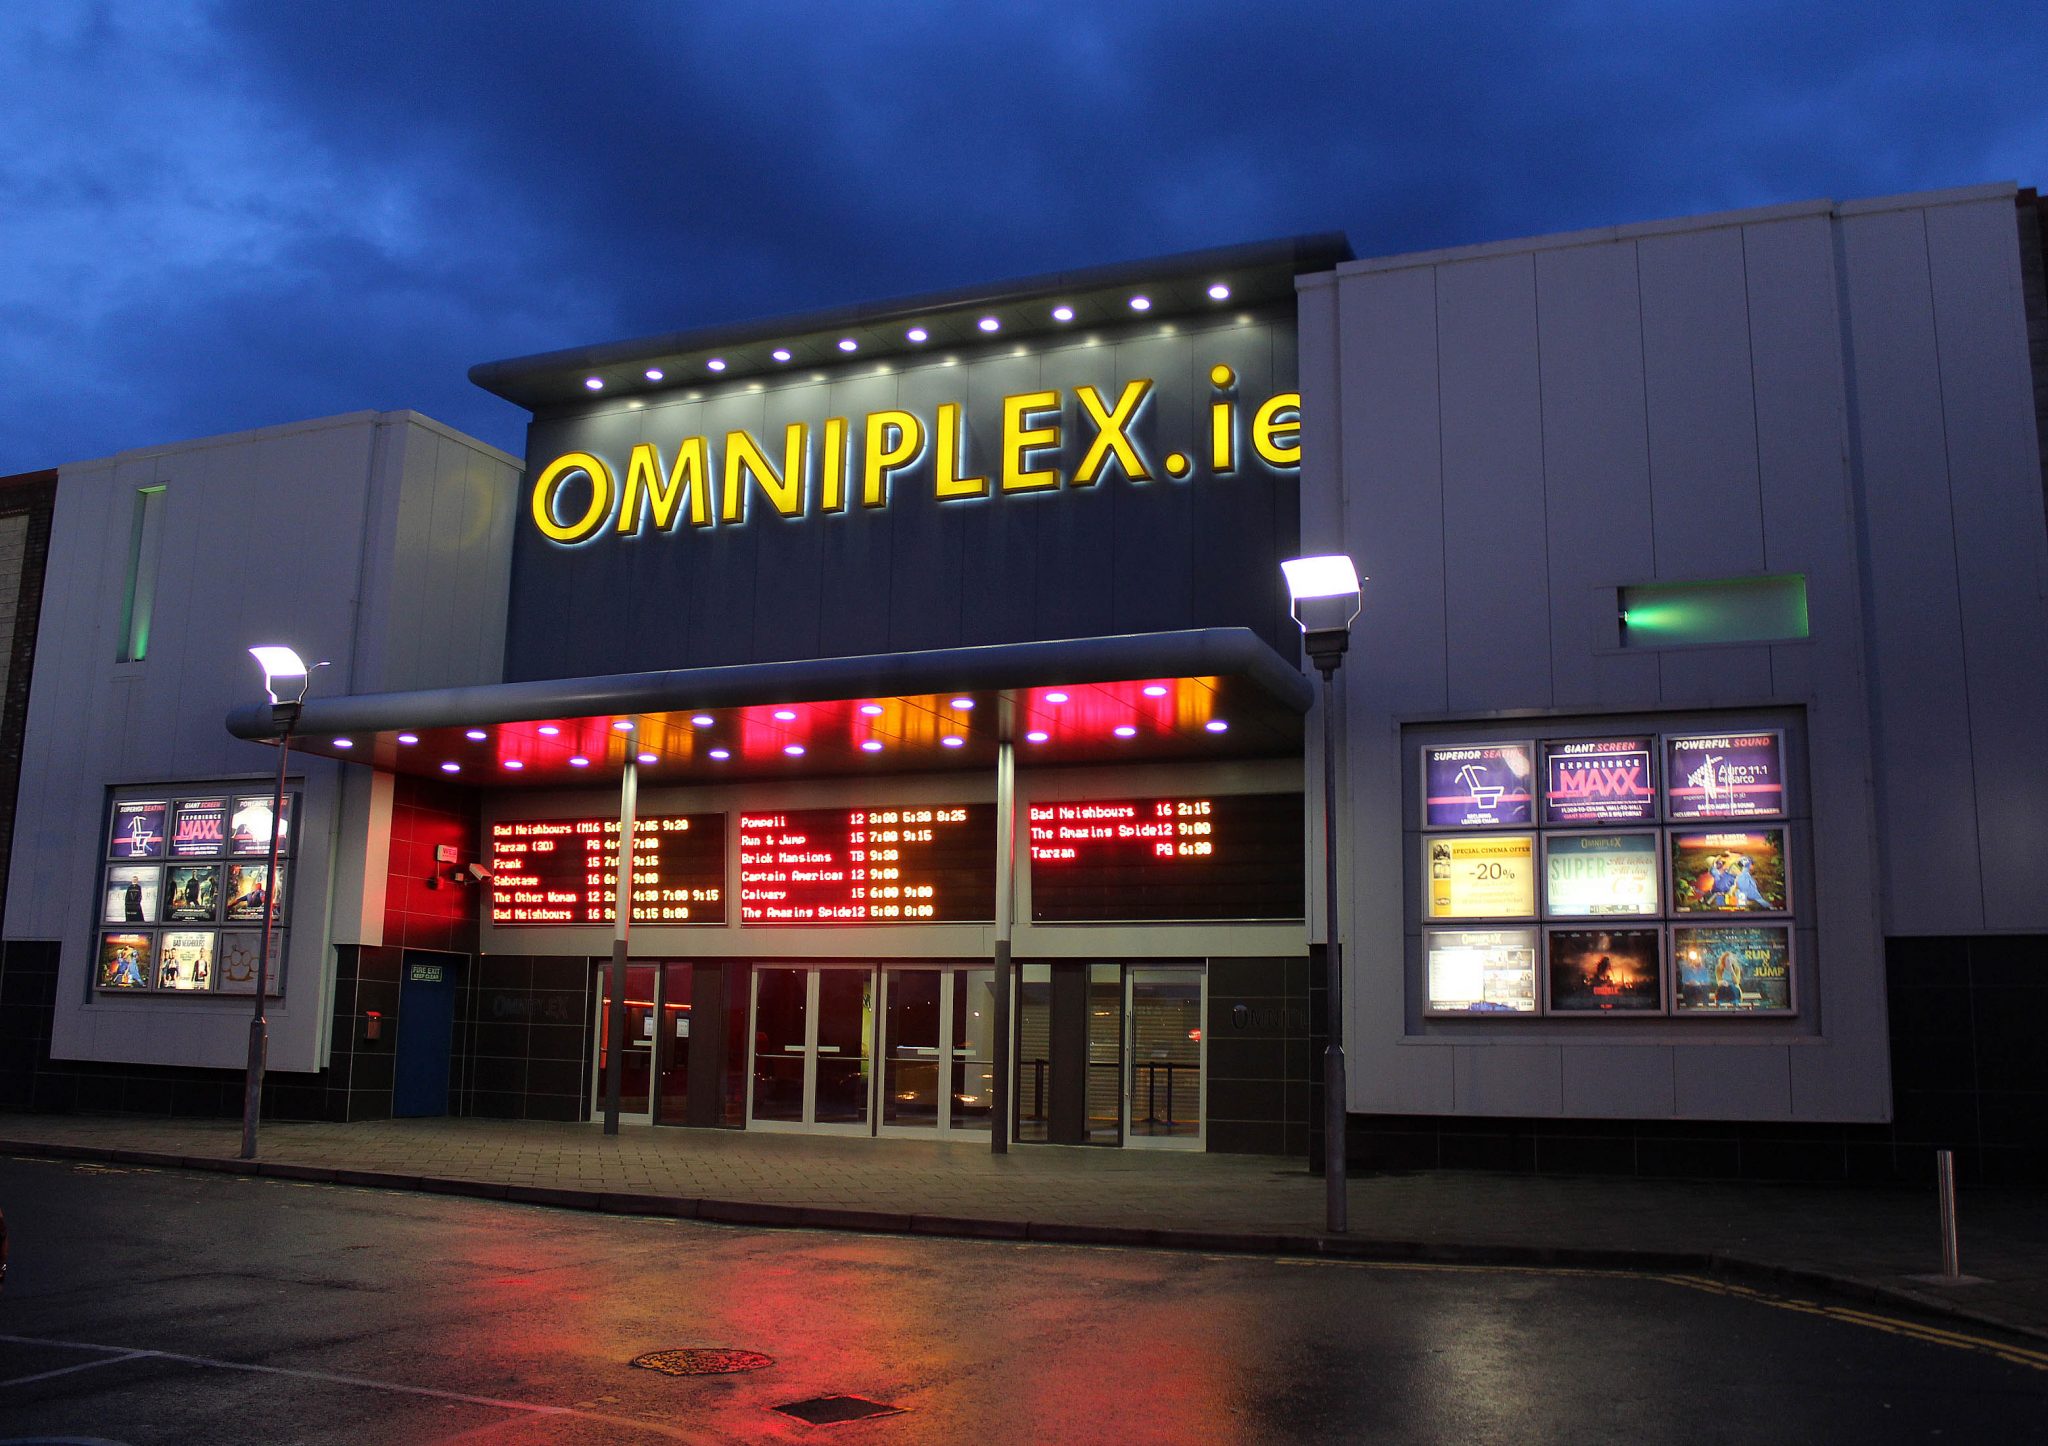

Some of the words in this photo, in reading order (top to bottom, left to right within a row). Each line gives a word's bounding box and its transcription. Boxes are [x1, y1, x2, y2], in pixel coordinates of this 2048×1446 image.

[531, 363, 1301, 545] OMNIPLEX.ie
[1564, 743, 1595, 753] GIANT
[1597, 742, 1636, 752] SCREEN
[1675, 738, 1731, 750] POWERFUL
[1734, 737, 1770, 748] SOUND
[1434, 750, 1481, 761] SUPERIOR
[1560, 759, 1640, 770] EXPERIENCE
[1748, 764, 1768, 775] 11.1
[1560, 767, 1640, 798] MAXX
[181, 813, 221, 821] EXPERIENCE
[851, 813, 864, 825] 12
[869, 812, 898, 824] 3:00
[903, 811, 931, 823] 5:30
[936, 810, 966, 822] 8:25
[1031, 807, 1053, 820] Bad
[1156, 803, 1172, 816] 16
[1178, 802, 1210, 815] 2:15
[180, 819, 222, 841] MAXX
[494, 825, 512, 836] Bad
[663, 819, 689, 830] 9:20
[1031, 827, 1053, 840] The
[1178, 821, 1211, 836] 9:00
[494, 842, 527, 853] Tarzan
[586, 839, 600, 850] PG
[633, 838, 659, 849] 7:00
[742, 835, 761, 847] Run
[779, 833, 806, 846] Jump
[850, 832, 864, 843] 15
[869, 830, 898, 842] 7:00
[903, 829, 932, 842] 9:15
[1031, 846, 1075, 859] Tarzan
[1156, 844, 1173, 856] PG
[1453, 847, 1479, 855] SPECIAL
[1480, 846, 1508, 854] CINEMA
[1509, 845, 1531, 853] OFFER
[494, 857, 522, 869] Frank
[587, 857, 600, 868] 15
[633, 855, 659, 867] 9:15
[742, 853, 774, 864] Brick
[778, 852, 832, 863] Mansions
[742, 870, 787, 883] Captain
[851, 868, 865, 880] 12
[869, 867, 898, 880] 9:00
[1468, 862, 1516, 880] -20%
[1551, 855, 1606, 881] SUPER
[494, 874, 538, 886] Sabotage
[587, 872, 600, 885] 16
[633, 872, 659, 885] 9:00
[494, 891, 513, 903] The
[516, 890, 543, 902] Other
[547, 890, 576, 902] Woman
[587, 890, 600, 902] 12
[663, 889, 689, 902] 7:00
[692, 888, 719, 901] 9:15
[742, 888, 787, 900] Calvary
[851, 887, 865, 899] 15
[869, 886, 898, 899] 6:00
[904, 885, 933, 898] 9:00
[494, 908, 512, 920] Bad
[587, 907, 600, 920] 16
[633, 906, 659, 920] 5:15
[663, 906, 689, 919] 8:00
[742, 906, 762, 918] The
[870, 904, 899, 917] 5:00
[904, 903, 934, 917] 8:00
[1744, 949, 1771, 961] RUN
[412, 966, 427, 974] FIRE
[428, 967, 441, 975] EXIT
[1754, 966, 1785, 977] JUMP
